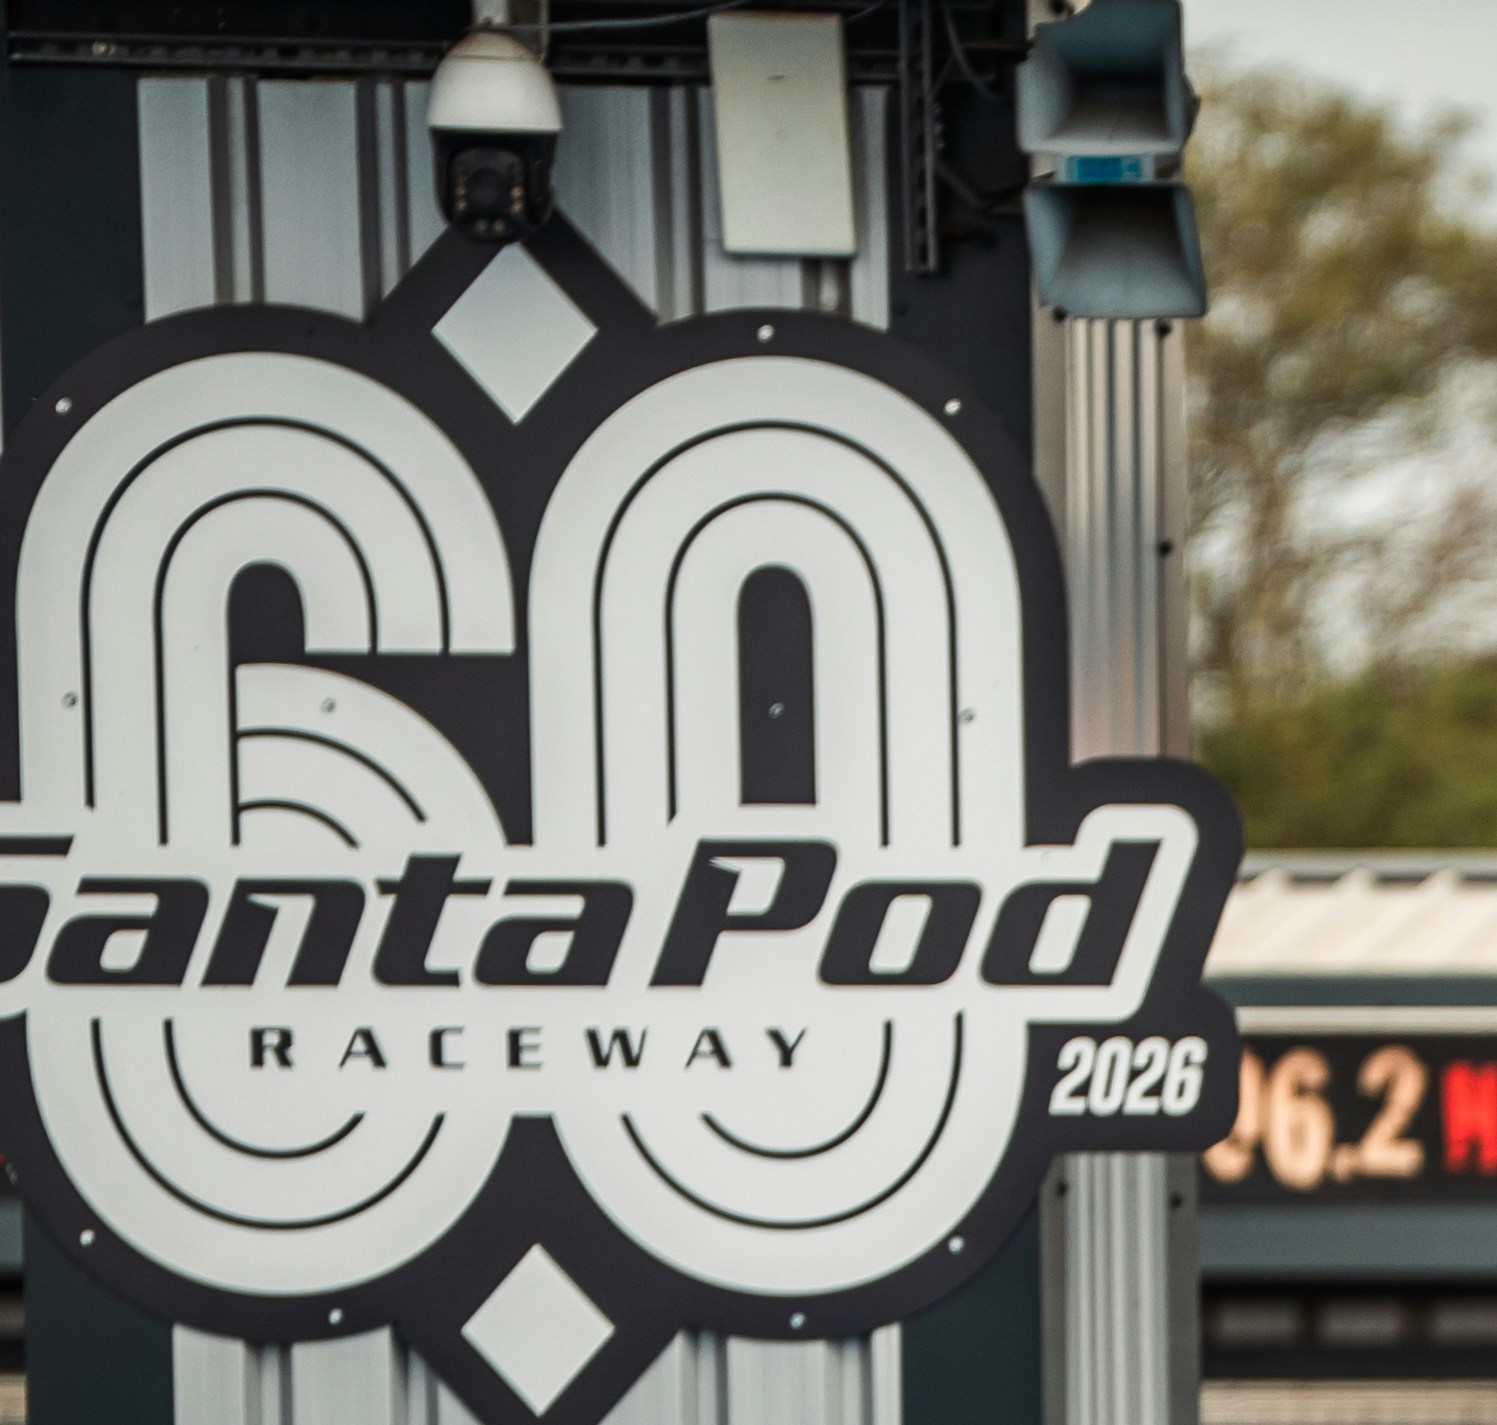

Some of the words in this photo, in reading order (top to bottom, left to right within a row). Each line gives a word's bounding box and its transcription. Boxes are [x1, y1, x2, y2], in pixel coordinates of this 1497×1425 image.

[16, 352, 1023, 1296] 60
[650, 838, 1162, 988] Pod
[251, 1025, 808, 1072] RACEWAY
[1048, 1036, 1206, 1117] 2026
